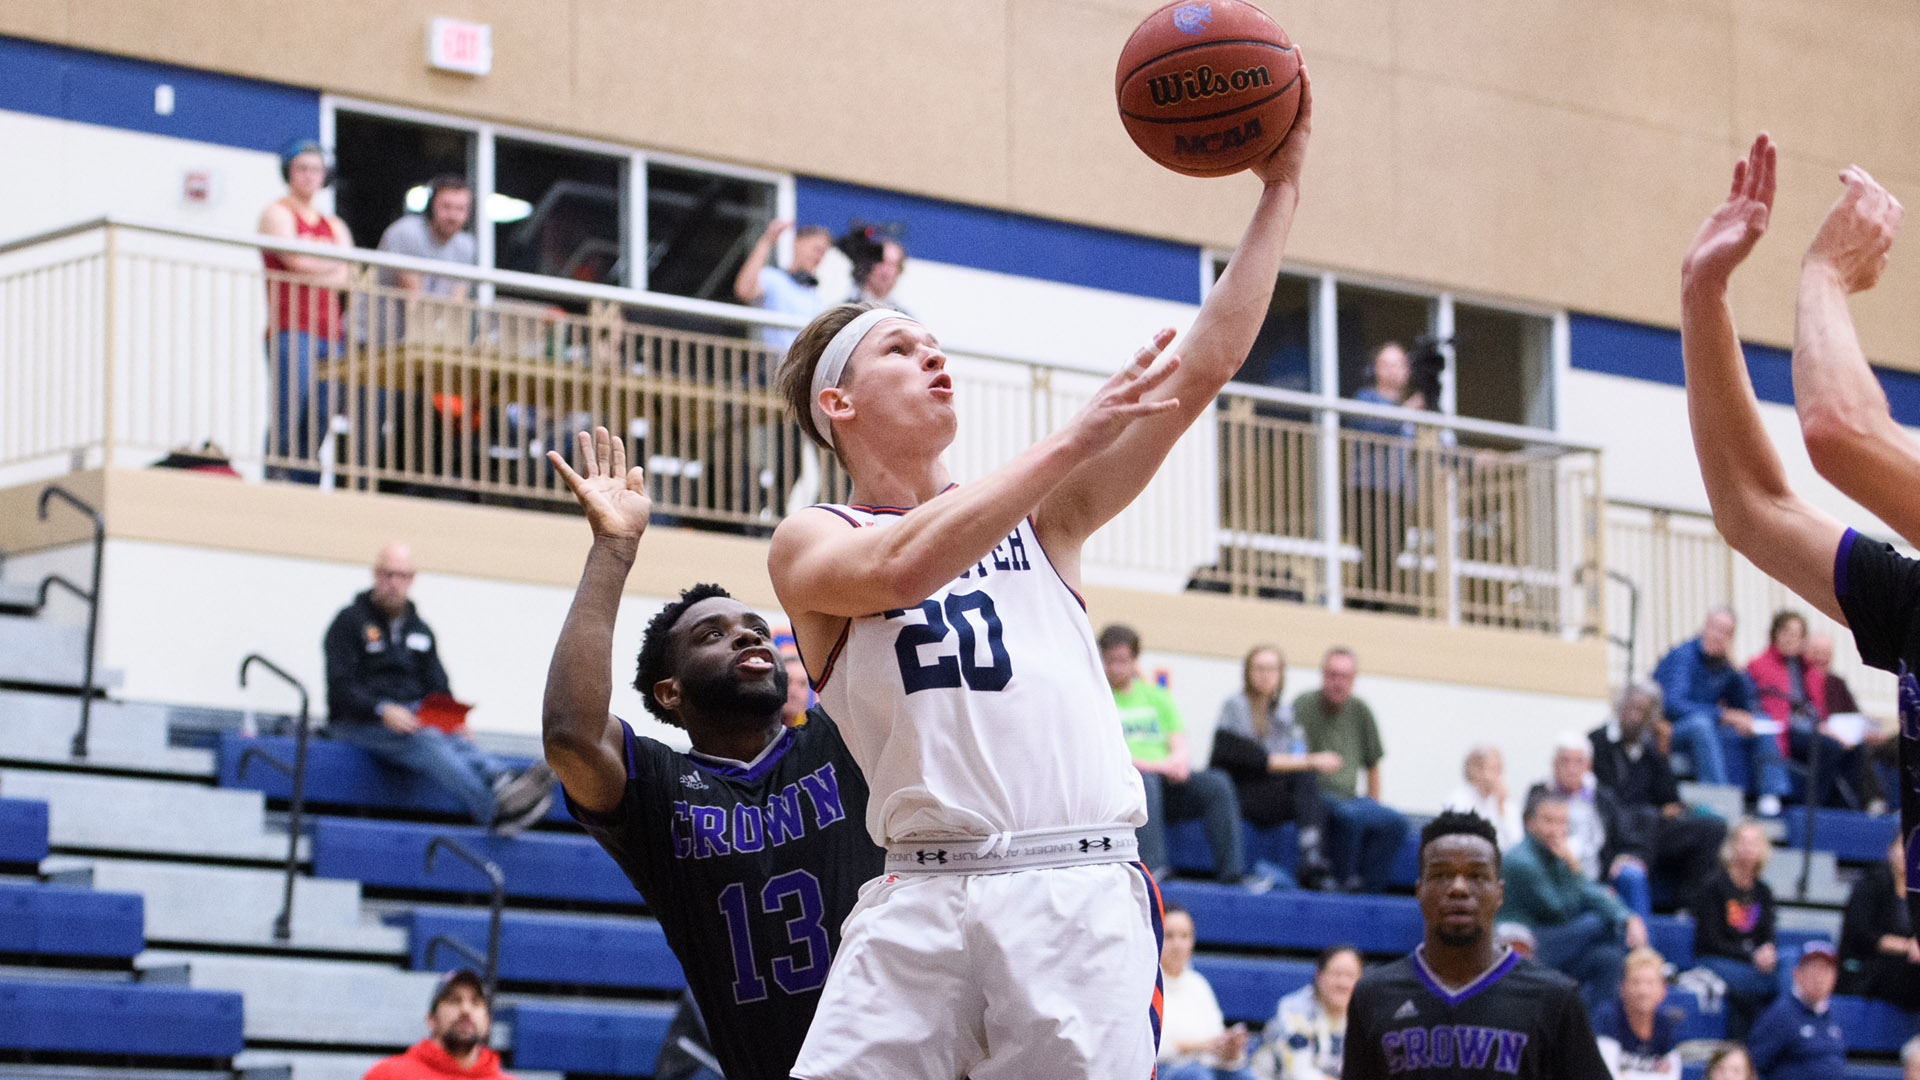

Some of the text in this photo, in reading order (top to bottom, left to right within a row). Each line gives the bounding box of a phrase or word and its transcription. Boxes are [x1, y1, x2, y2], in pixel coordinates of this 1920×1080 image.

[1147, 65, 1272, 107] Wilson
[883, 589, 1013, 695] 20
[671, 762, 846, 860] CROWN
[717, 867, 832, 1005] 13
[1382, 1024, 1529, 1076] CROWN
